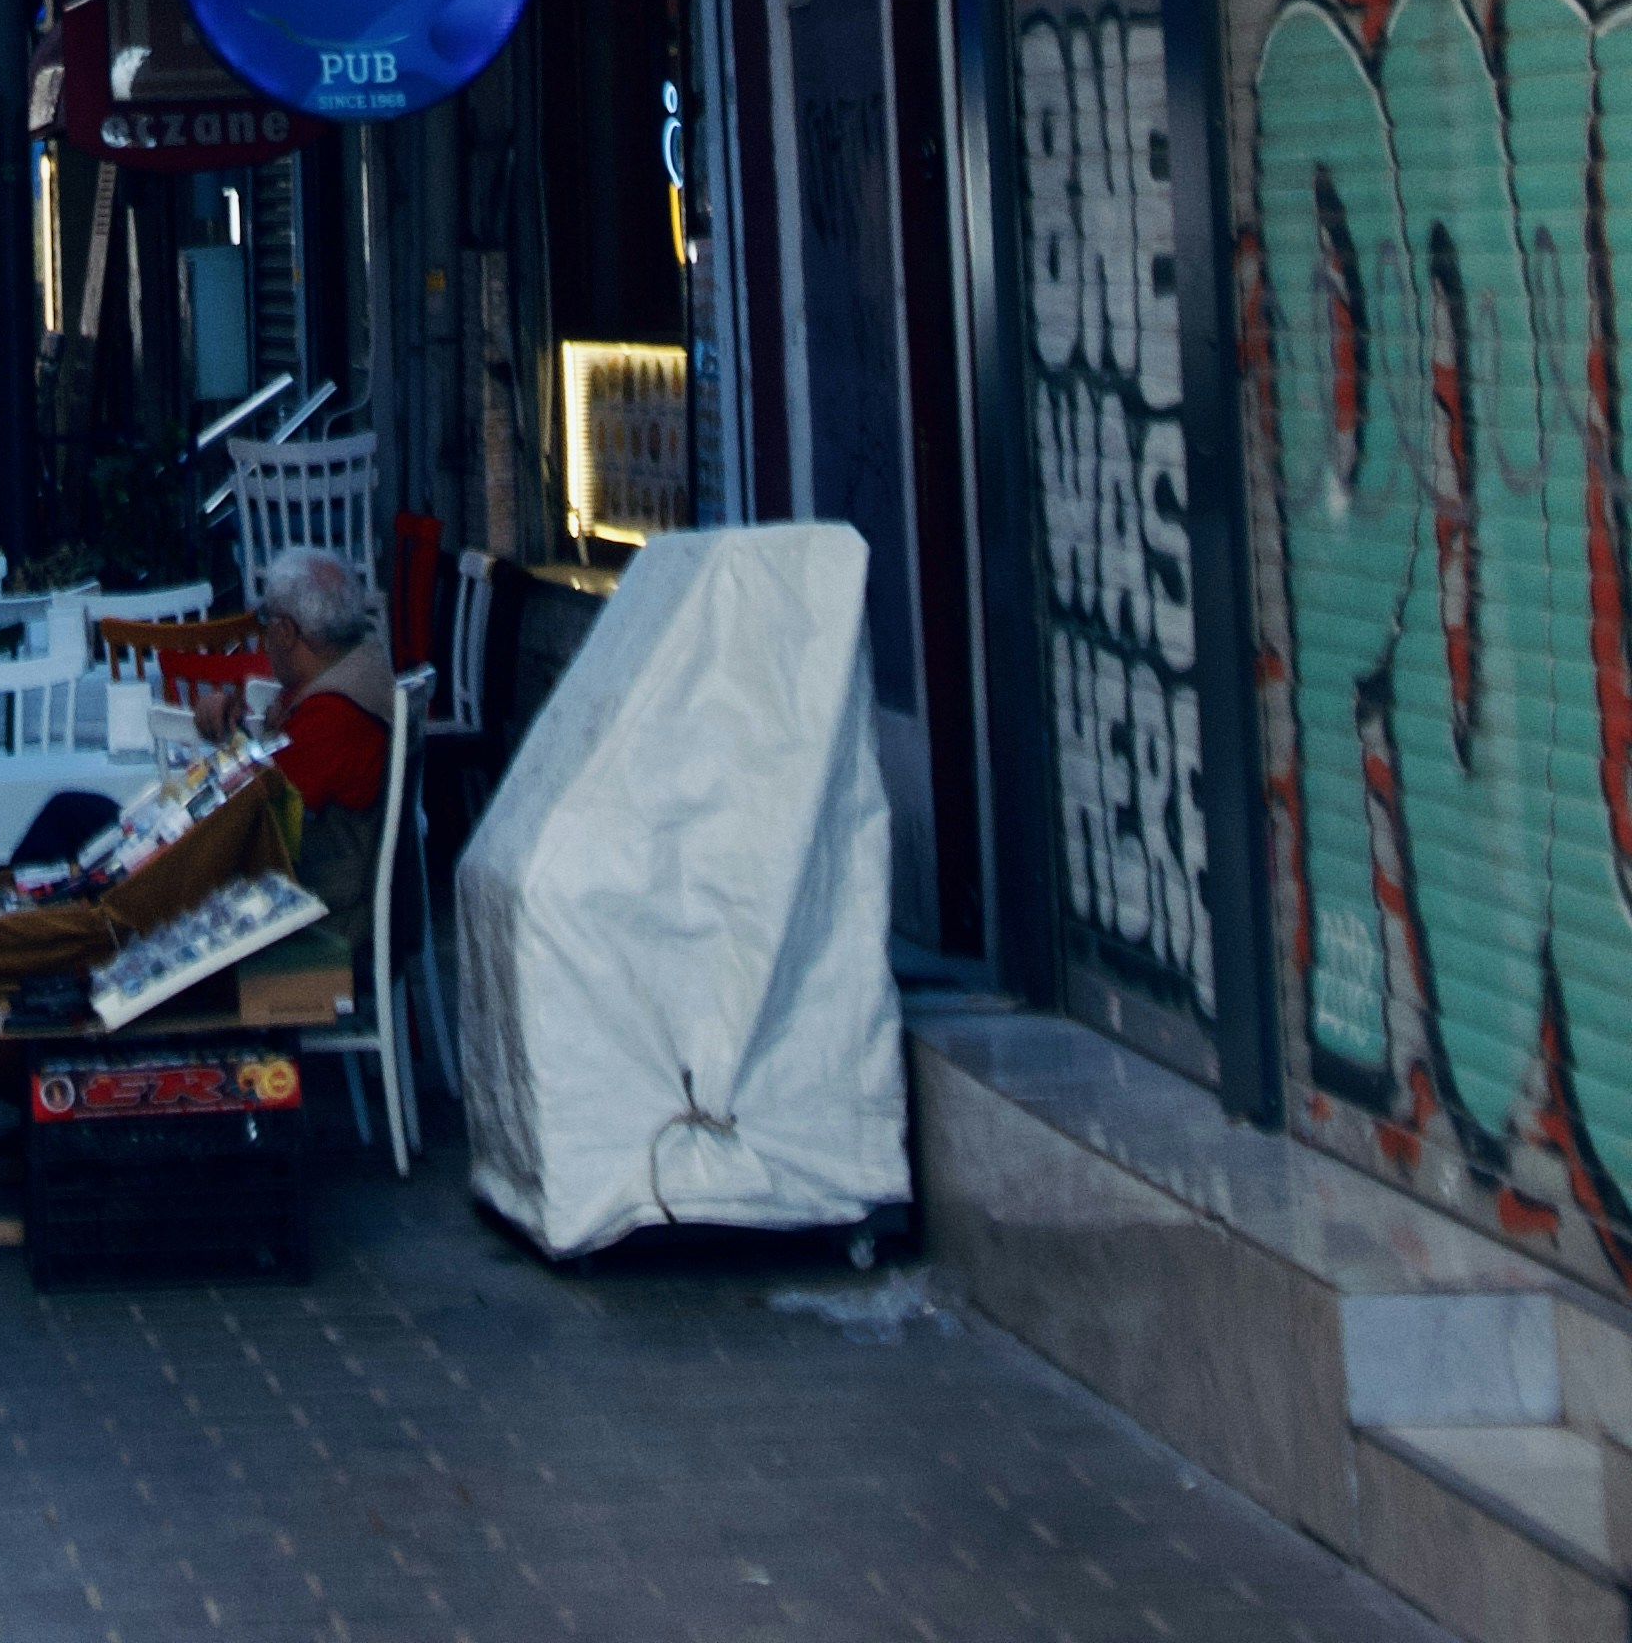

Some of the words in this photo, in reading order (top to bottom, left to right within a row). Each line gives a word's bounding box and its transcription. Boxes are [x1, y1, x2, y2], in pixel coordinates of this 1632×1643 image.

[319, 50, 398, 85] PUB
[319, 94, 368, 110] SINCE
[1035, 375, 1198, 672] WAS
